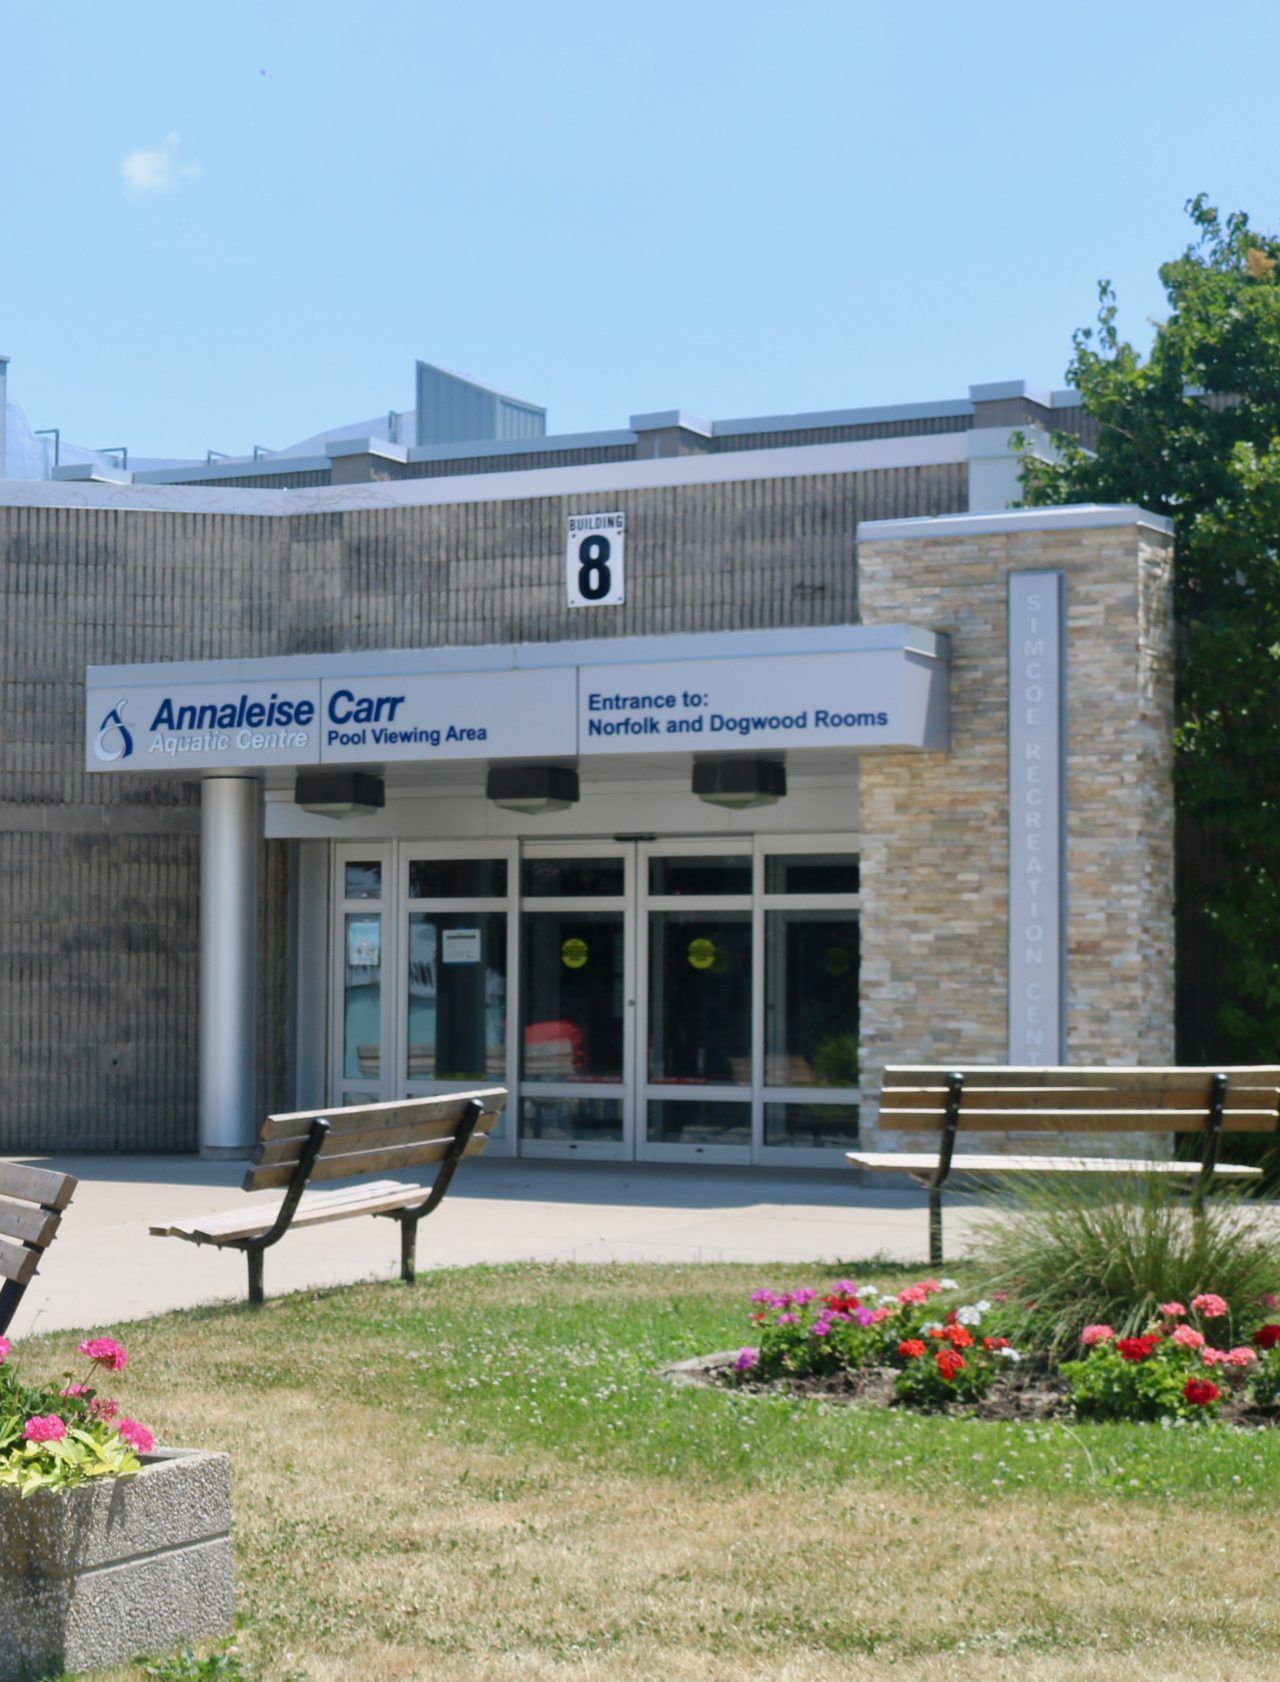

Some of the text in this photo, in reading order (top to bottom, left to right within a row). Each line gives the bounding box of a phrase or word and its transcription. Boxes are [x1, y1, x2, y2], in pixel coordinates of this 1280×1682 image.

[569, 515, 623, 531] BUILDING
[578, 534, 611, 600] 8
[1024, 594, 1044, 725] SIMCOE
[149, 689, 405, 732] Annaleise Carr
[588, 690, 709, 711] Entrance to:
[328, 725, 487, 746] Pool Viewing Area
[588, 709, 888, 736] Norfolk and Dogwood Rooms
[148, 729, 308, 757] Aquatic Centre
[1024, 743, 1043, 965] RECREATION
